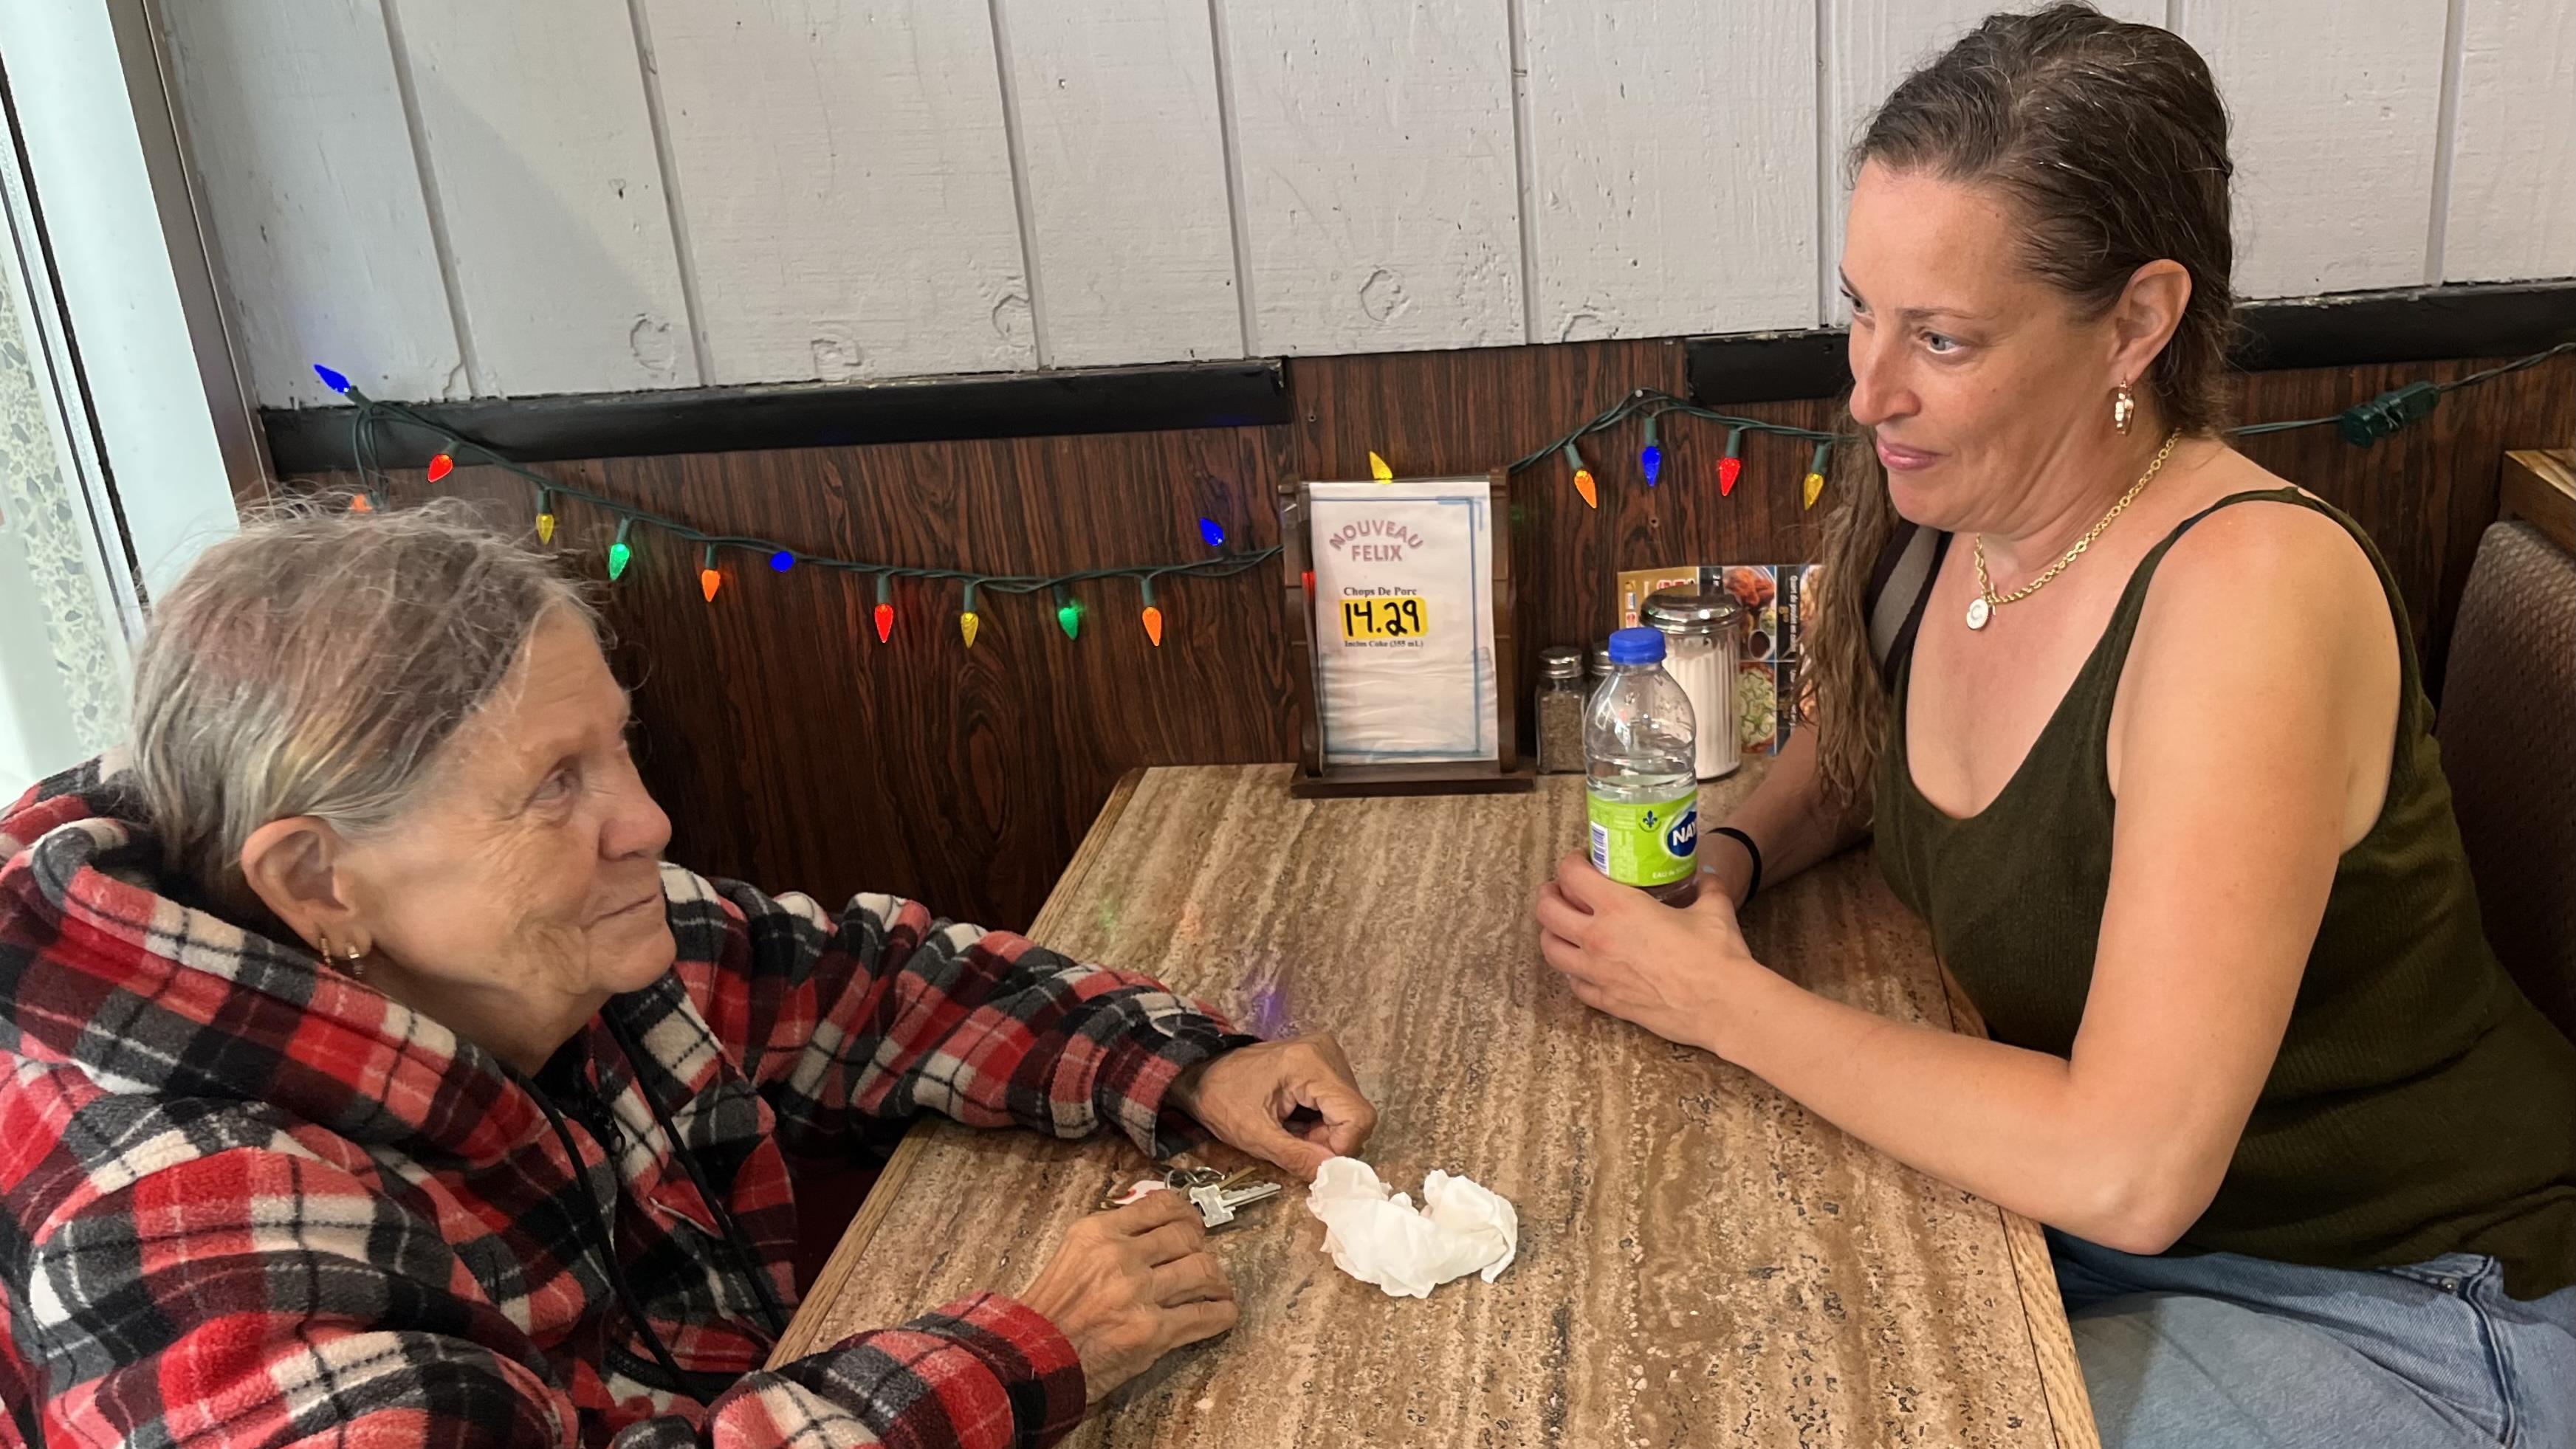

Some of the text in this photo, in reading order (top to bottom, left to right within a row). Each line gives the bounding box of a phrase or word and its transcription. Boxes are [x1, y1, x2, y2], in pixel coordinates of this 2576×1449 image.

[1329, 520, 1423, 551] NOUVEAU
[1351, 545, 1402, 562] FELIX
[1344, 587, 1417, 598] Chops De Porc
[1345, 599, 1420, 637] 14.29
